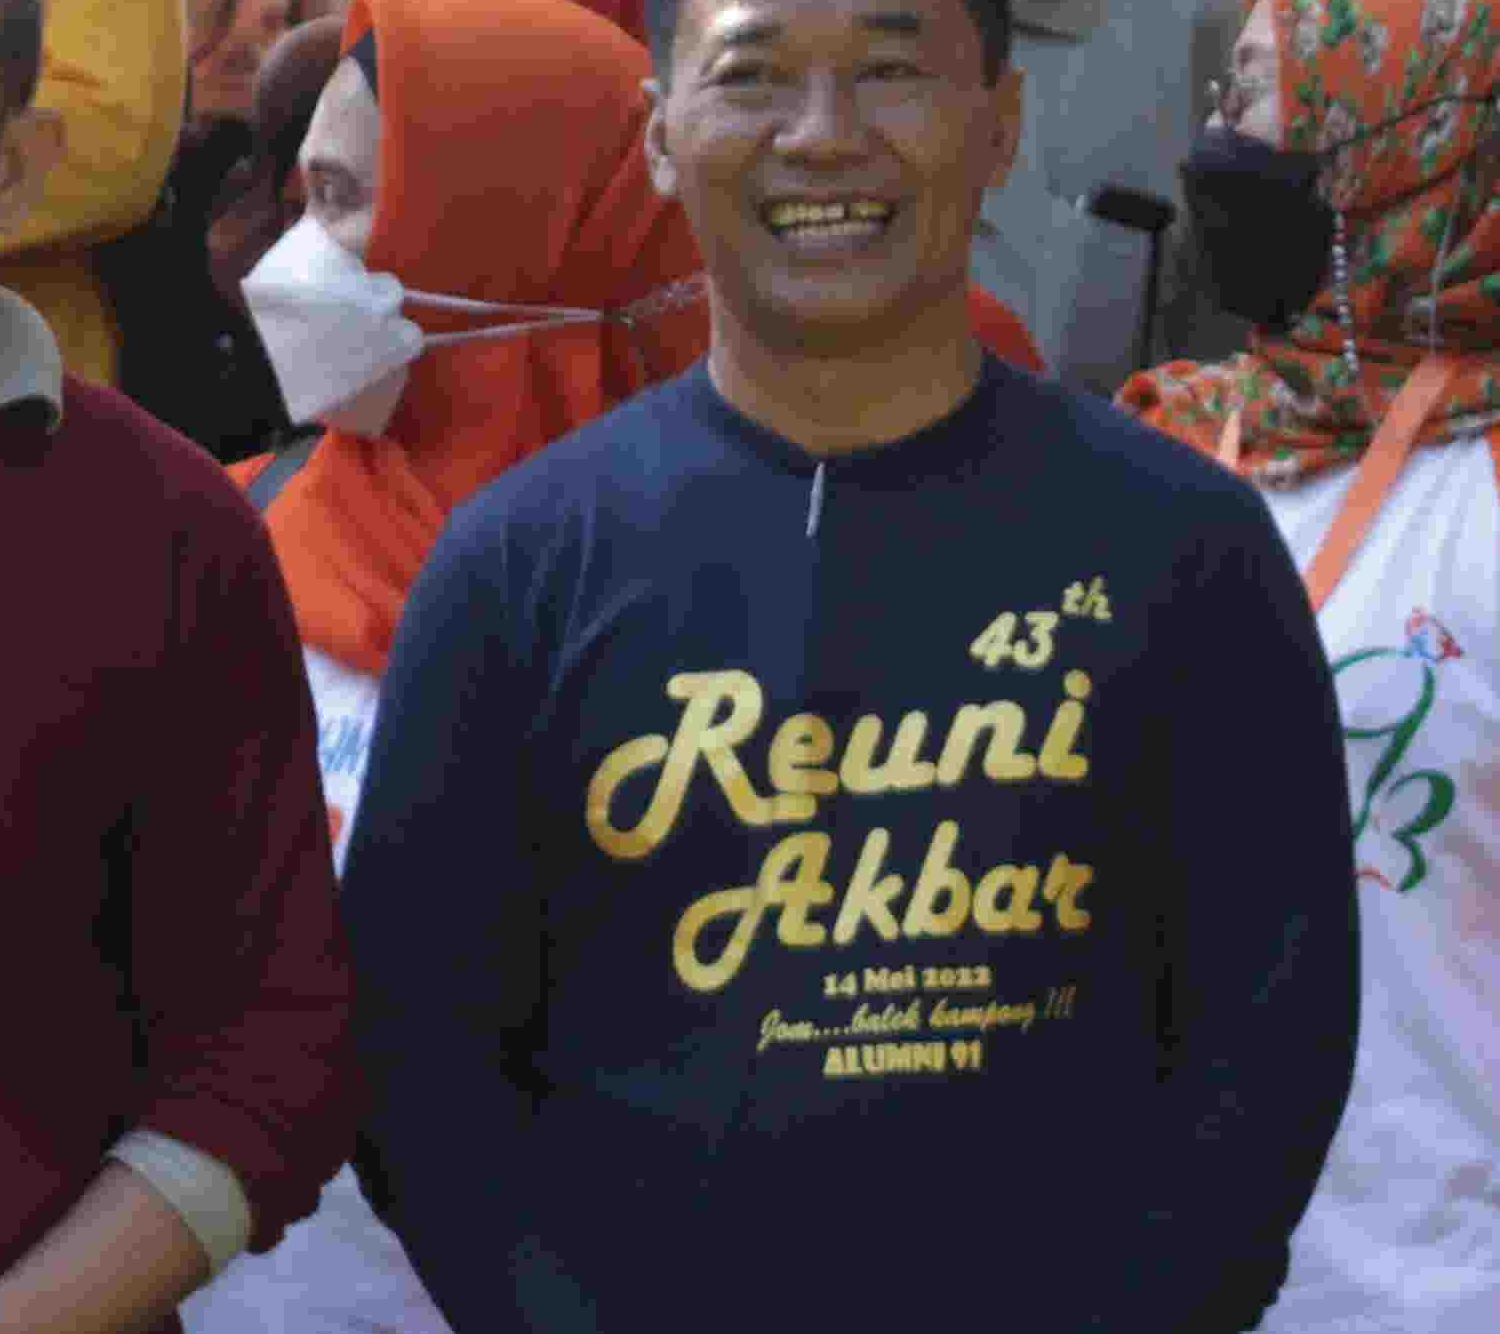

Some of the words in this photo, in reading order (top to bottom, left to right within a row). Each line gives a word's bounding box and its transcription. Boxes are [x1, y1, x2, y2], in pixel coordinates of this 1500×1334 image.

[585, 668, 1093, 860] Reuni
[672, 819, 1093, 993] Akbar
[823, 1041, 945, 1077] ALUMNI
